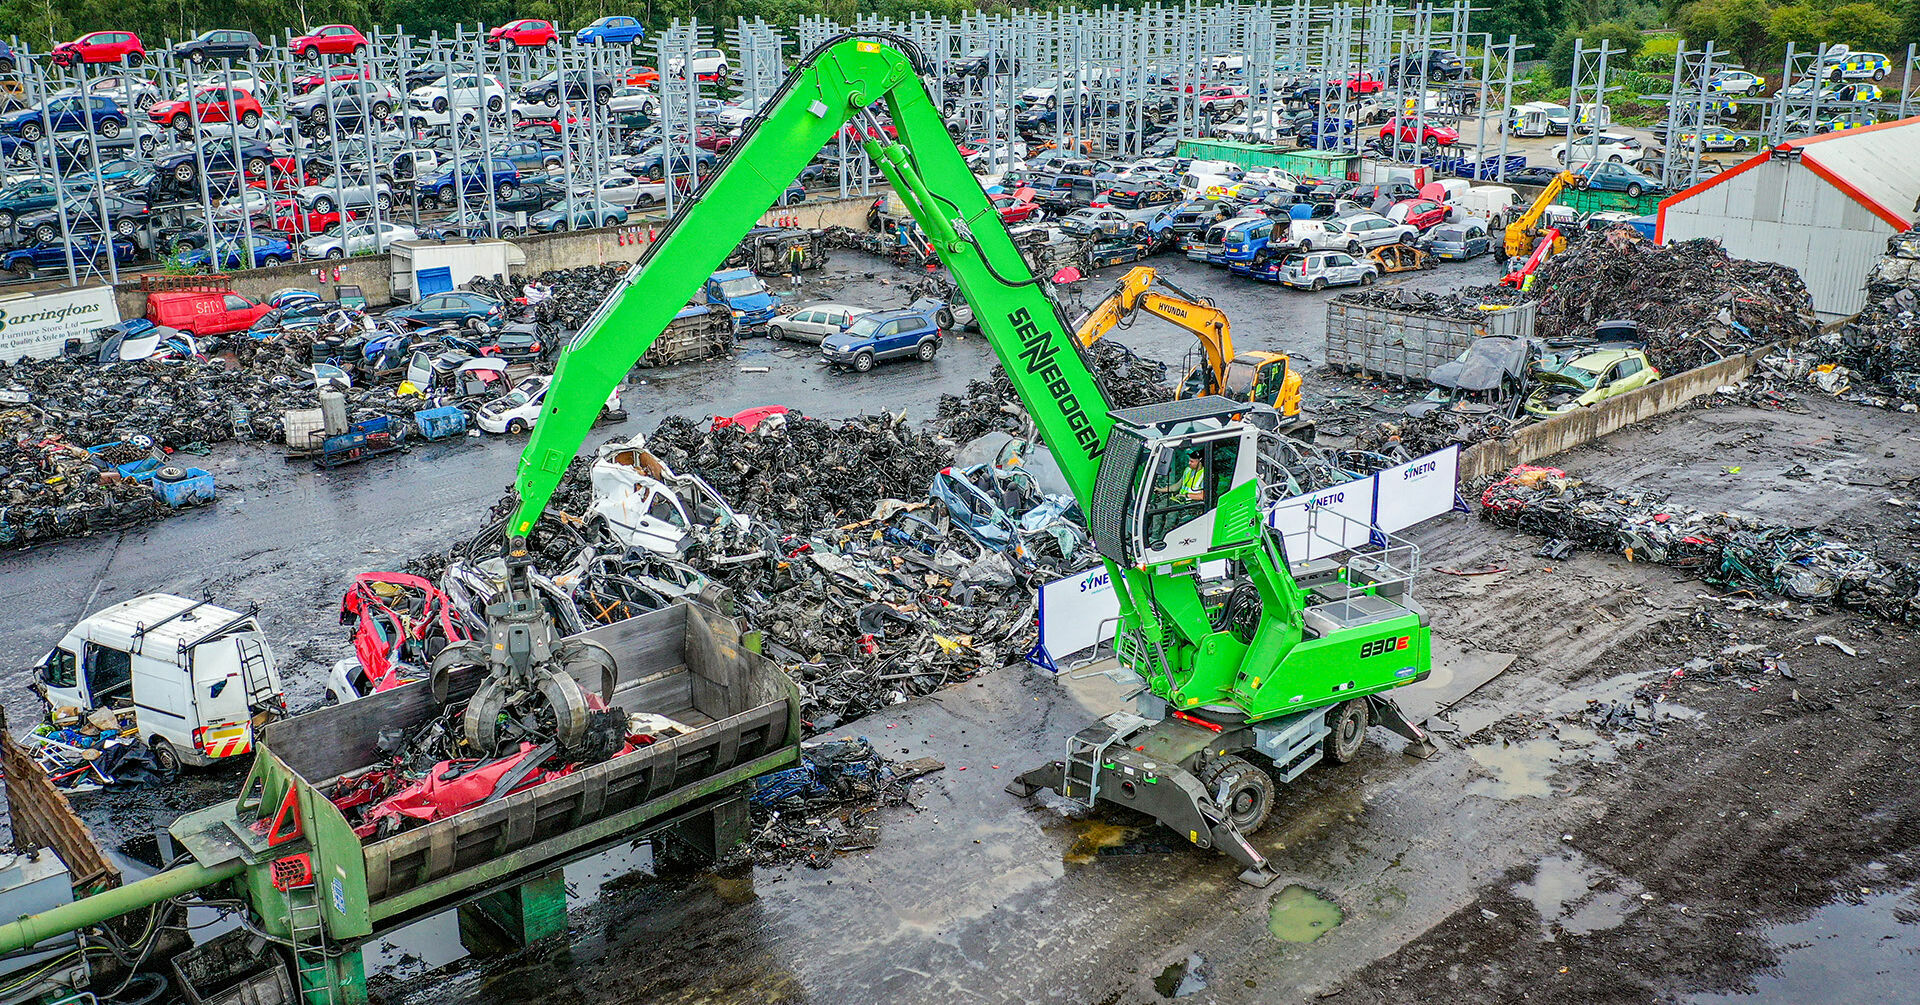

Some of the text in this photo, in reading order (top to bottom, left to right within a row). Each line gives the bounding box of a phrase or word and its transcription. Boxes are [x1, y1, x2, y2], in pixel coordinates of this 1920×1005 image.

[1158, 302, 1188, 319] HYUNDAI
[1, 321, 79, 340] Furniture Store Ltd
[10, 336, 33, 348] Quality
[42, 333, 58, 342] Style
[66, 328, 81, 337] Your
[1006, 306, 1103, 461] SENNEBOGEN
[1404, 460, 1436, 480] SYNETIQ
[1304, 492, 1344, 511] SYNETIQ
[1360, 635, 1410, 659] 830E
